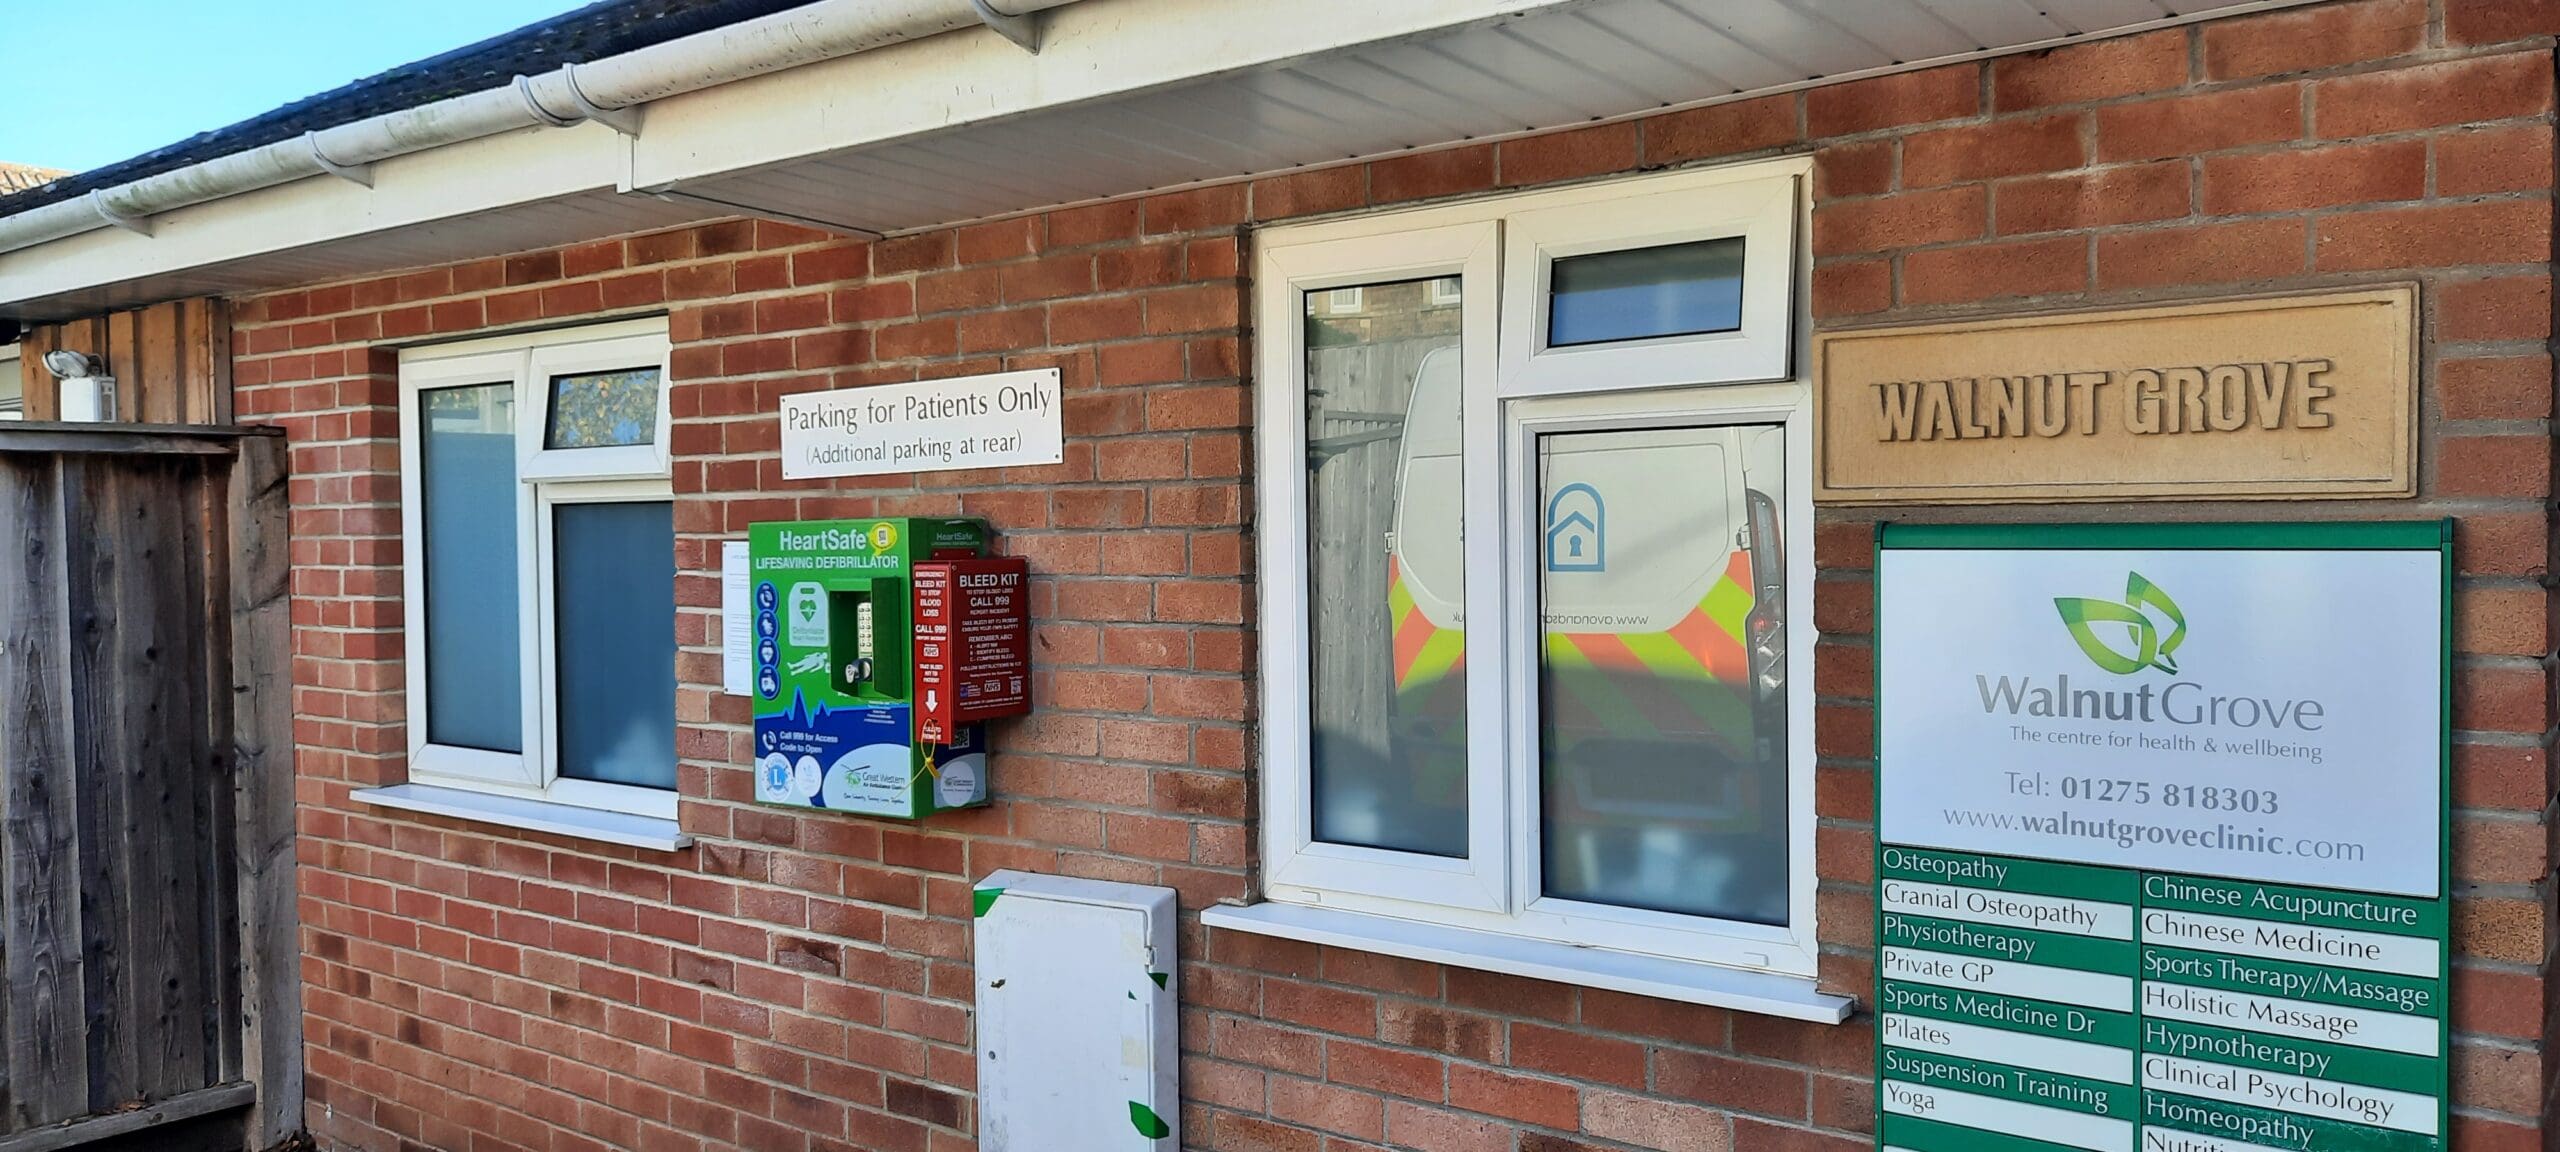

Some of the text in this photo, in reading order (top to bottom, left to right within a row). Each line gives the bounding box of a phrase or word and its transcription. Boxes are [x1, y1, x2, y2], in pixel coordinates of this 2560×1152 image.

[789, 382, 1052, 434] Parking for Patients Only
[1869, 359, 2333, 442] WALNUT GROVE
[806, 429, 1023, 465] (Additional parking at rear)
[780, 529, 867, 551] HeartSafe
[756, 555, 899, 569] LIFESAVING DEFIBRILLATOR
[960, 573, 1019, 587] BLEED KIT
[915, 580, 946, 588] BLEED KIT
[920, 598, 942, 606] BLOOD
[970, 595, 1010, 607] CALL 999
[915, 624, 947, 634] CALL 999
[923, 609, 939, 617] LOSS
[2009, 725, 2323, 764] The centre for health & wellbeing
[2004, 771, 2279, 815] Tel: 01275 818303
[1943, 807, 2365, 861] www.walnutgroveclinic.com
[1883, 849, 2008, 887] Osteopathy
[1884, 883, 2098, 933] Cranial Osteopathy
[2145, 876, 2417, 925] Chinese Acupuncture
[1884, 916, 2036, 960] Physiotherapy
[2145, 913, 2380, 960] Chinese Medicine
[1884, 951, 1994, 982] Private GP
[2145, 950, 2429, 1012] Sports Therapy/Massage
[1885, 983, 2096, 1034] Sports Medicine Dr
[2146, 985, 2358, 1040] Holistic Massage
[1885, 1017, 1951, 1045] Pilates
[2146, 1022, 2331, 1077] Hypnotherapy
[1886, 1050, 2108, 1114] Suspension Training
[1887, 1083, 1935, 1114] Yoga
[2145, 1057, 2394, 1123] Clinical Psychology
[2146, 1095, 2314, 1149] Homeopathy
[2147, 1131, 2225, 1152] Nutriti
